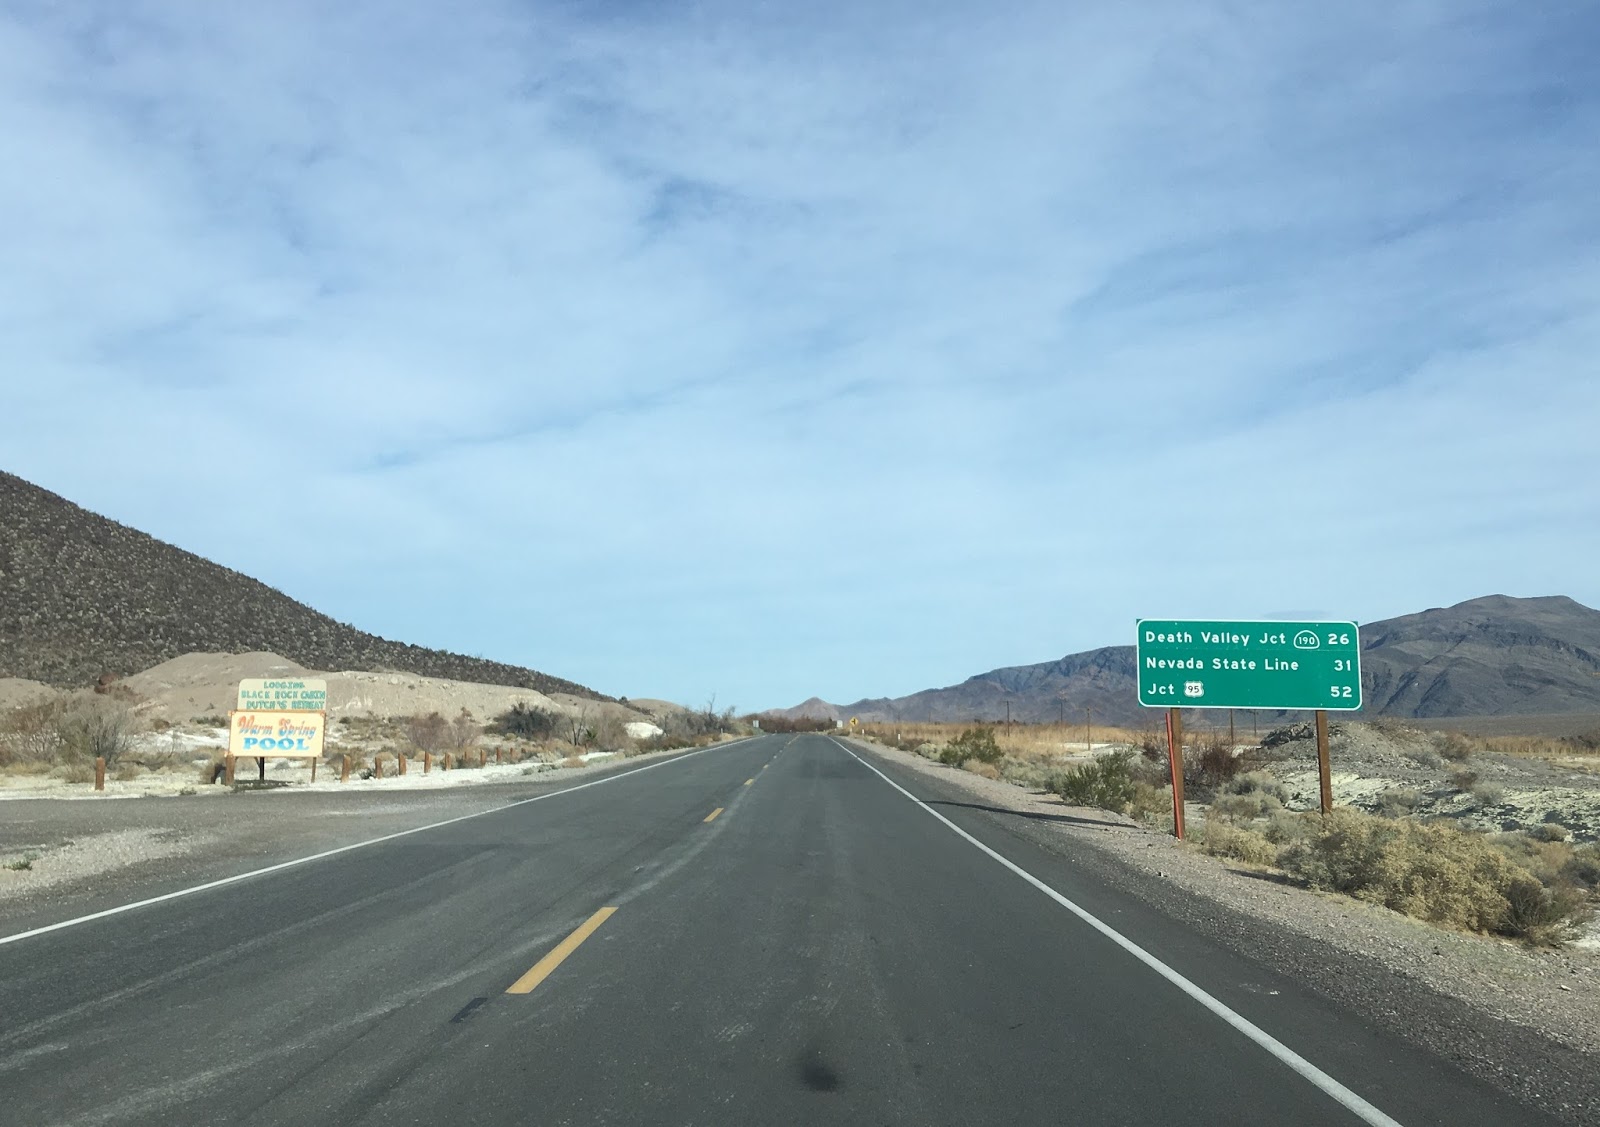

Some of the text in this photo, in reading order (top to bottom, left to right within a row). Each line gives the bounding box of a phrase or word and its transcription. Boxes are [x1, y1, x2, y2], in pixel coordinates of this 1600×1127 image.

[1145, 631, 1350, 646] Death Valley Jct 190 26
[1146, 657, 1351, 671] Nevada State Line 31
[241, 690, 270, 699] BLACK
[274, 690, 298, 699] ROCK
[1147, 683, 1353, 698] Jct 95 52
[246, 700, 325, 709] DUTCH'S RETREAT
[243, 737, 310, 750] POOL
